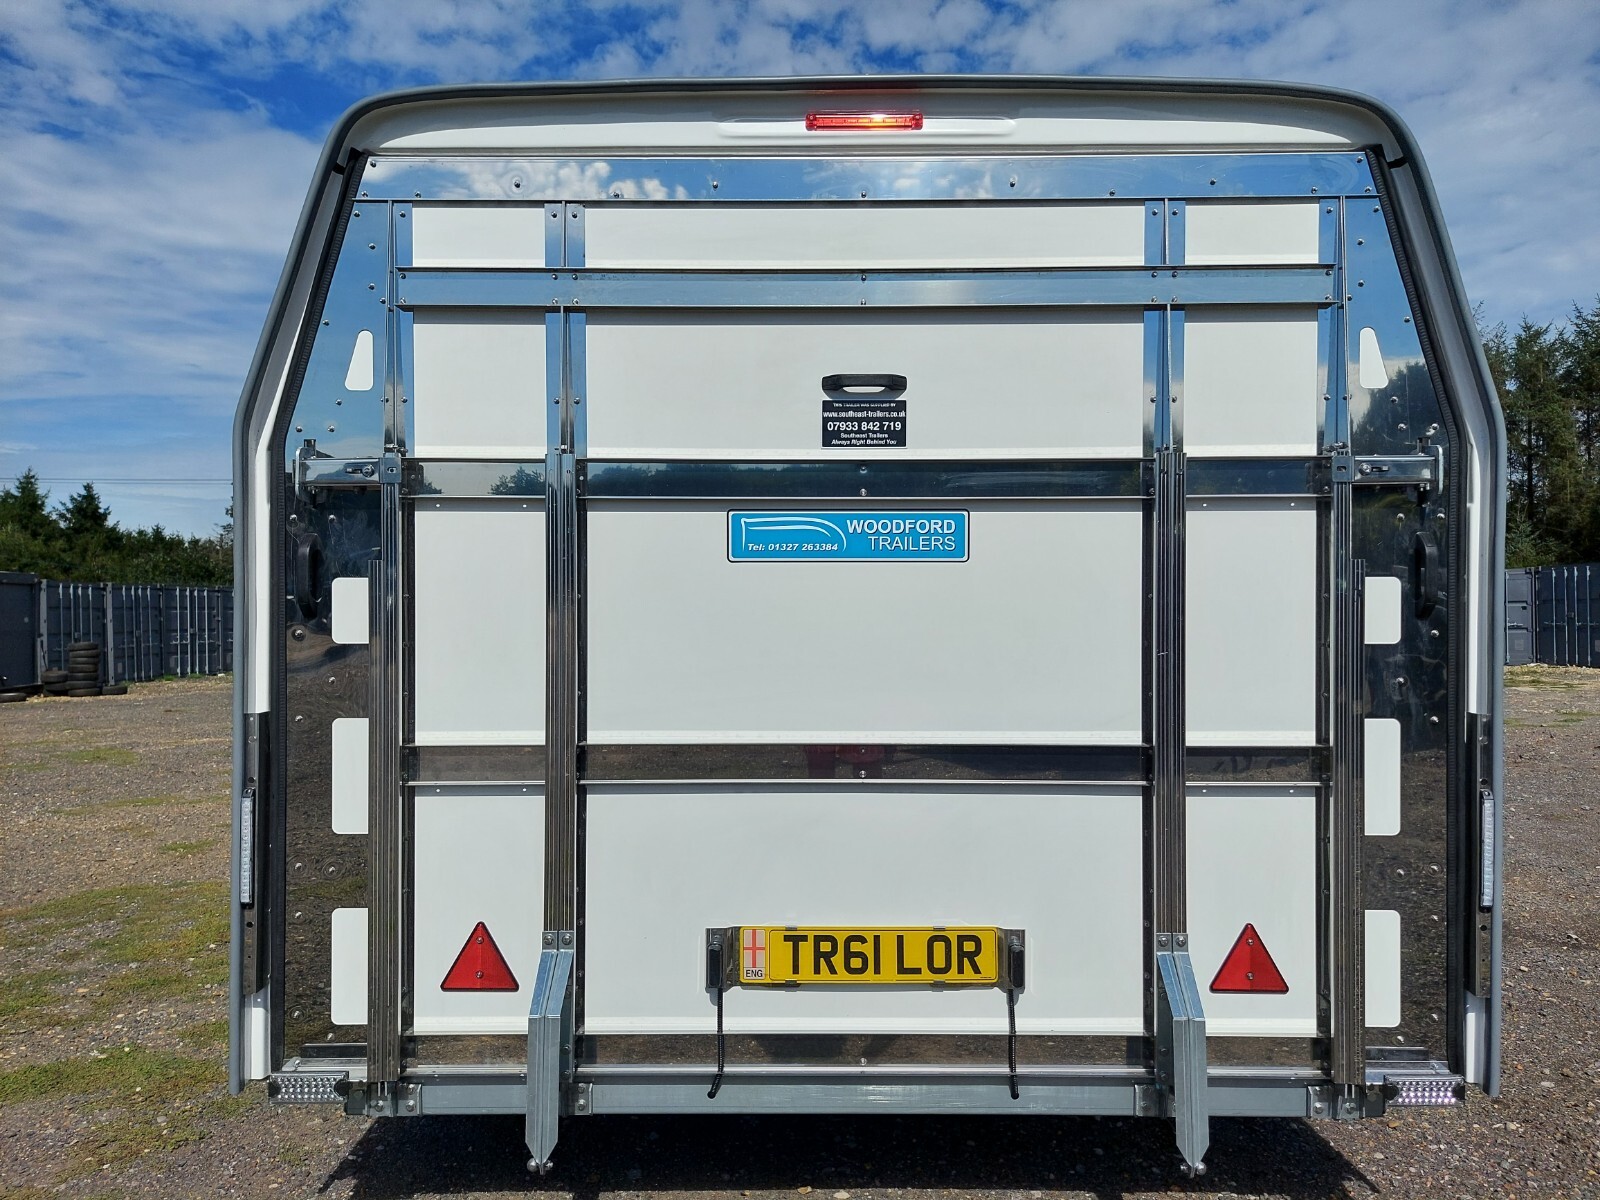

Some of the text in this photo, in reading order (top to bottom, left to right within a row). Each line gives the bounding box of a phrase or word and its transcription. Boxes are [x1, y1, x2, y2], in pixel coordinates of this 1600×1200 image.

[827, 421, 902, 431] 07933 842 719
[846, 519, 956, 534] WOODFORD
[748, 543, 838, 551] Tel: 01327 263384
[867, 536, 956, 551] TRAILERS
[745, 969, 763, 978] ENG
